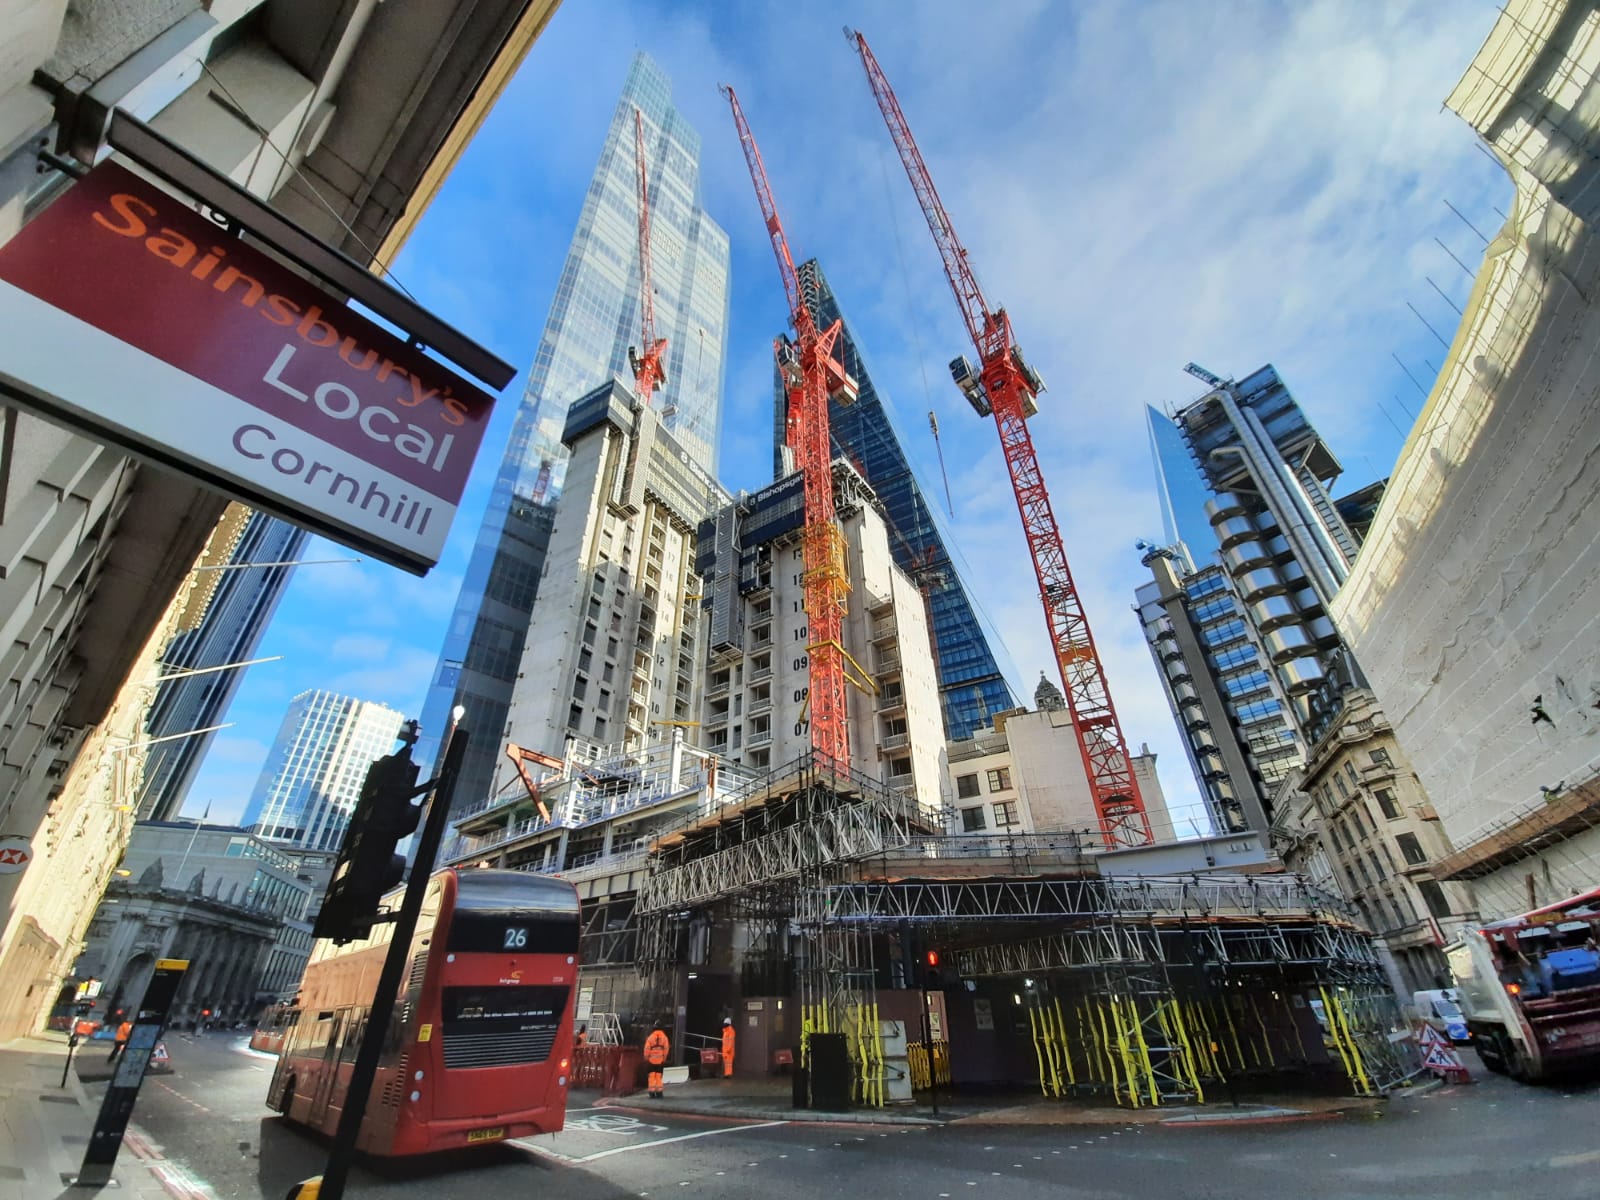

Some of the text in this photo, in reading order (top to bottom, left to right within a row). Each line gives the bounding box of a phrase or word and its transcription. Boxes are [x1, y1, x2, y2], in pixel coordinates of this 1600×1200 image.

[92, 193, 468, 426] Sainsbury's
[262, 343, 455, 472] Local
[232, 424, 433, 536] Cornhill
[757, 473, 803, 503] Bishopsgat
[794, 626, 807, 641] 10
[656, 654, 665, 667] 12
[793, 656, 808, 671] 09
[654, 677, 662, 690] 11
[651, 702, 660, 714] 10
[505, 928, 526, 947] 26
